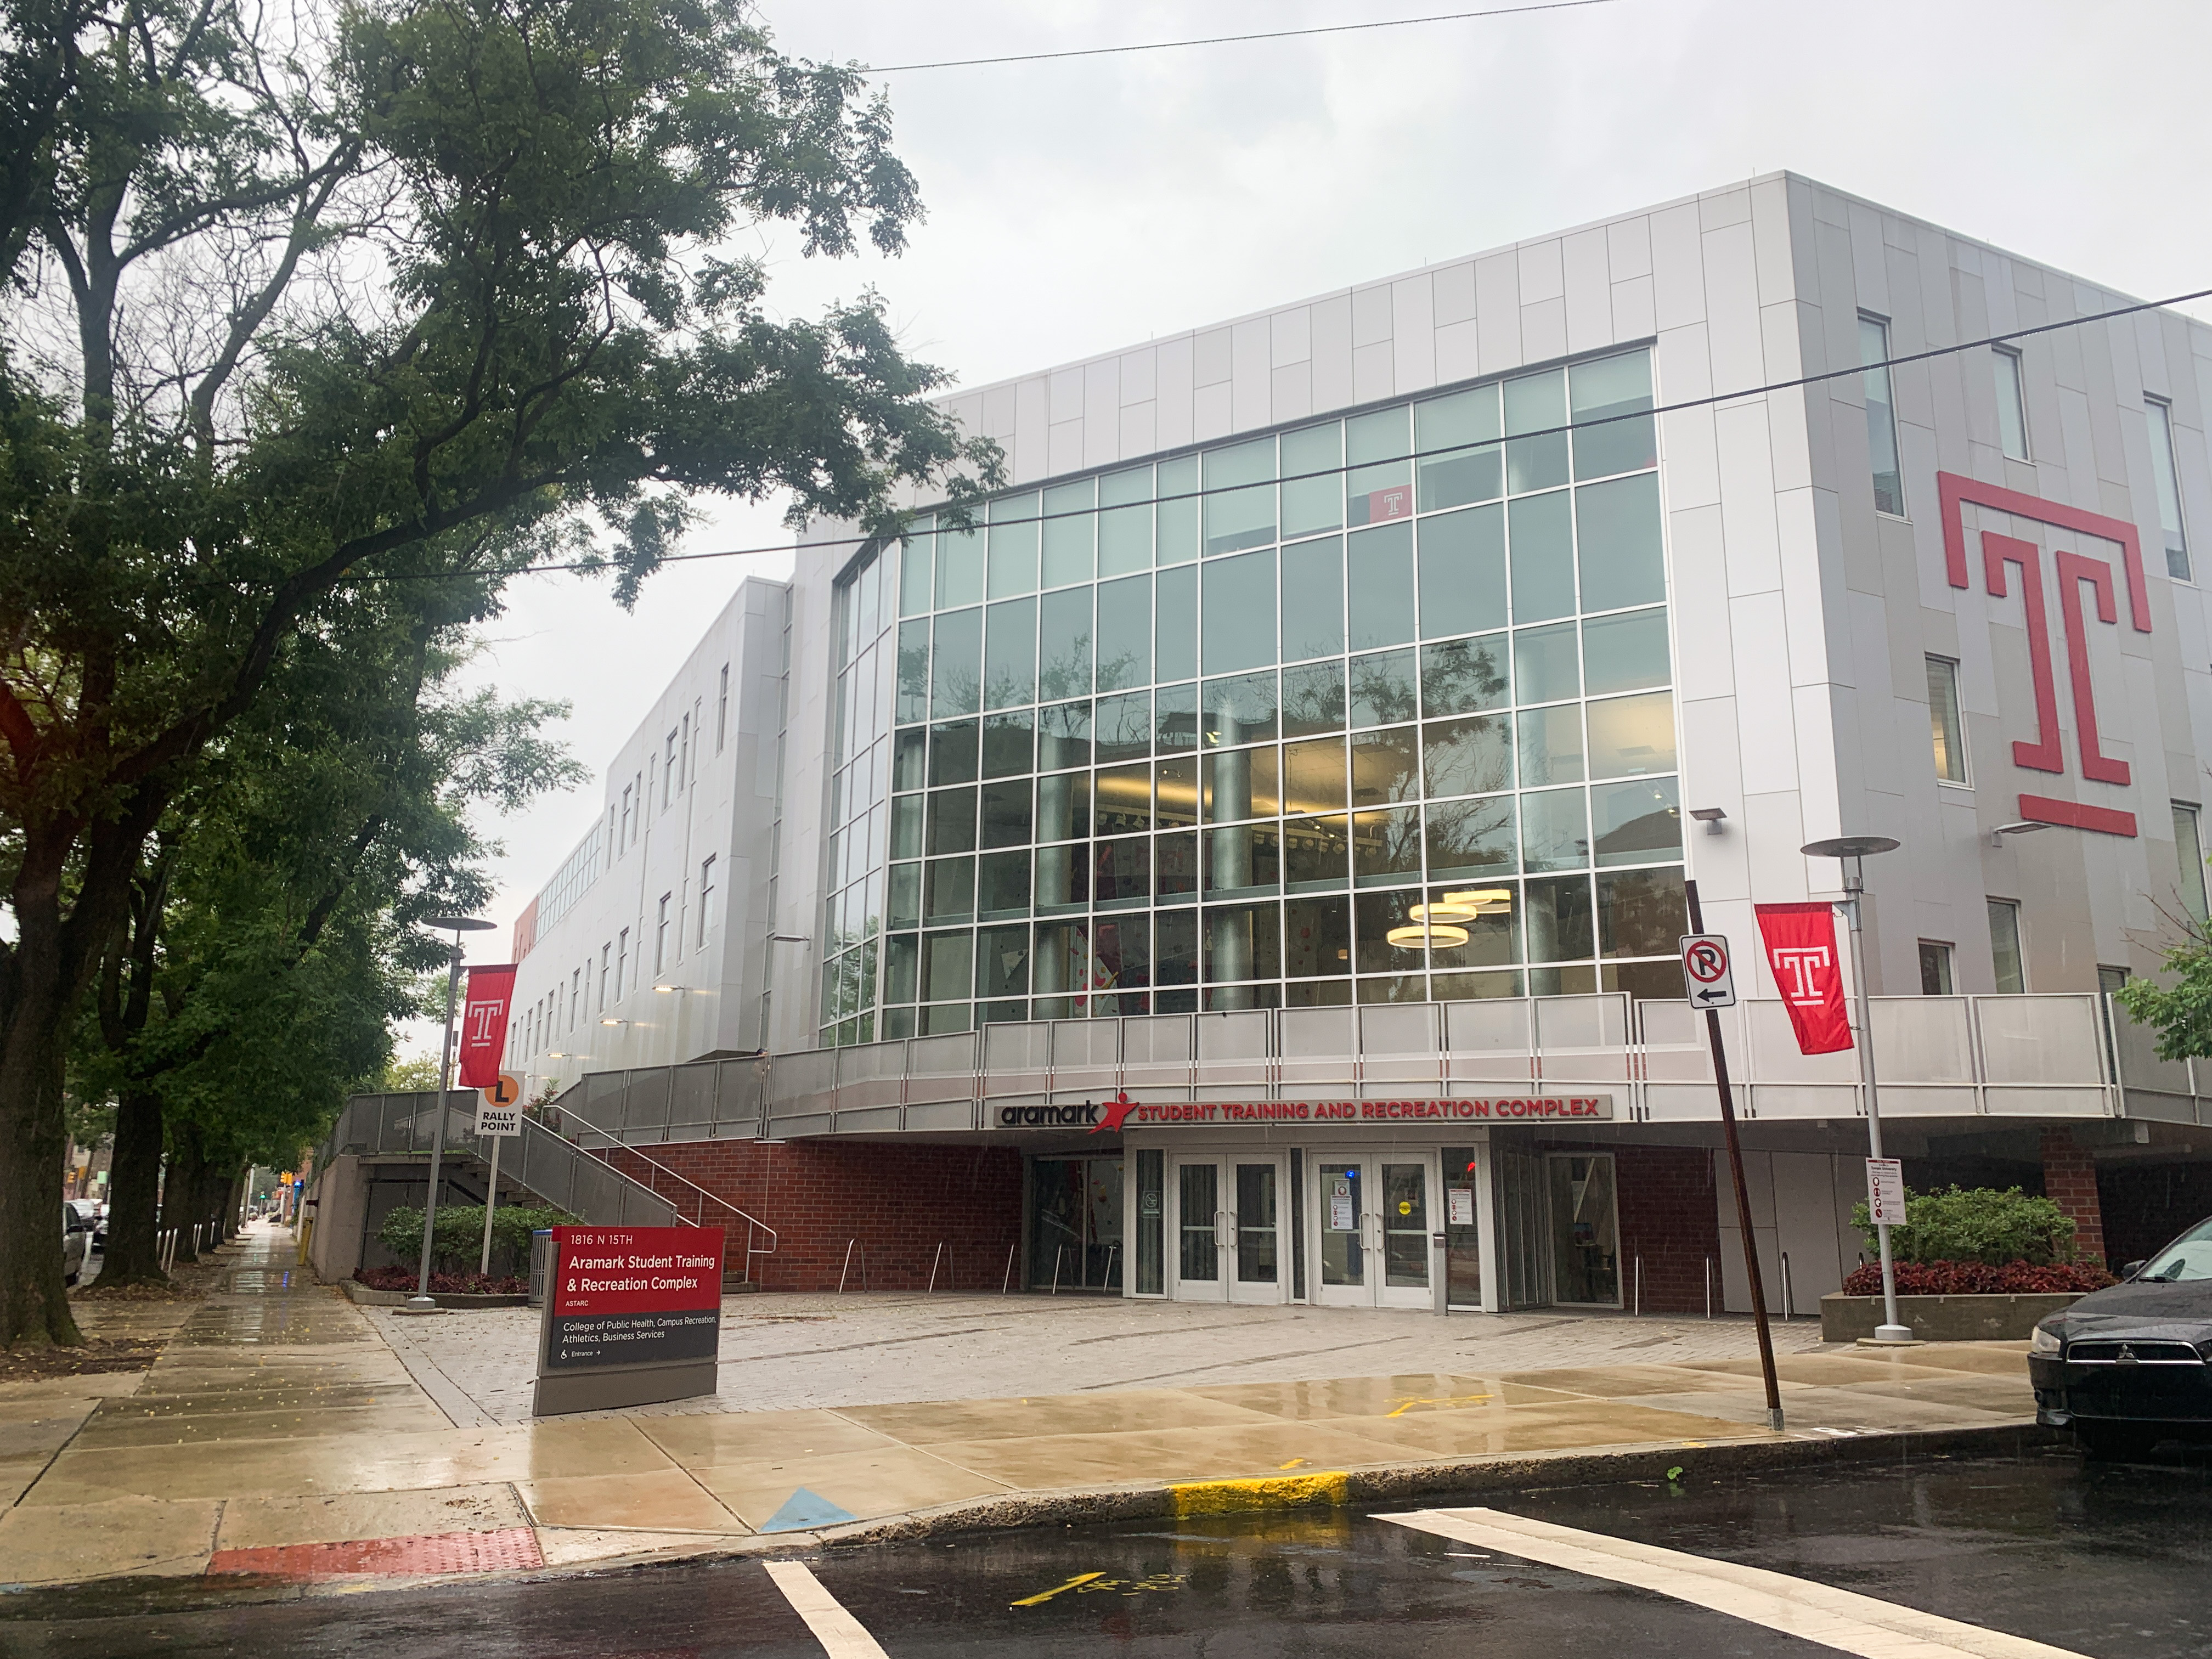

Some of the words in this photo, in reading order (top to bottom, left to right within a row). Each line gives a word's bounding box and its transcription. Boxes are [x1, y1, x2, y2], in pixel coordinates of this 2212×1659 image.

[495, 1081, 509, 1102] L
[483, 1112, 516, 1121] RALLY
[1001, 1099, 1099, 1125] aramark
[1138, 1103, 1217, 1121] STUDENT
[1221, 1103, 1309, 1120] TRAINING
[1314, 1102, 1356, 1118] AND
[1362, 1100, 1489, 1118] RECREATION
[1496, 1098, 1599, 1116] COMPLEX
[481, 1122, 516, 1131] POINT
[571, 1234, 593, 1245] 1816
[597, 1235, 605, 1245] N
[609, 1235, 633, 1245] 15TH
[569, 1256, 624, 1269] Aramark
[628, 1255, 673, 1269] Student
[676, 1255, 715, 1269] Training
[567, 1278, 577, 1292] &
[581, 1277, 648, 1292] Recreation
[651, 1276, 698, 1291] Complex
[563, 1322, 595, 1333] College
[596, 1321, 605, 1330] of
[607, 1319, 630, 1330] Public
[631, 1318, 656, 1329] Health,
[657, 1318, 684, 1328] Campus
[685, 1316, 716, 1325] Recreation,
[562, 1334, 601, 1344] Athletics,
[603, 1332, 635, 1342] Business
[636, 1330, 665, 1340] Services
